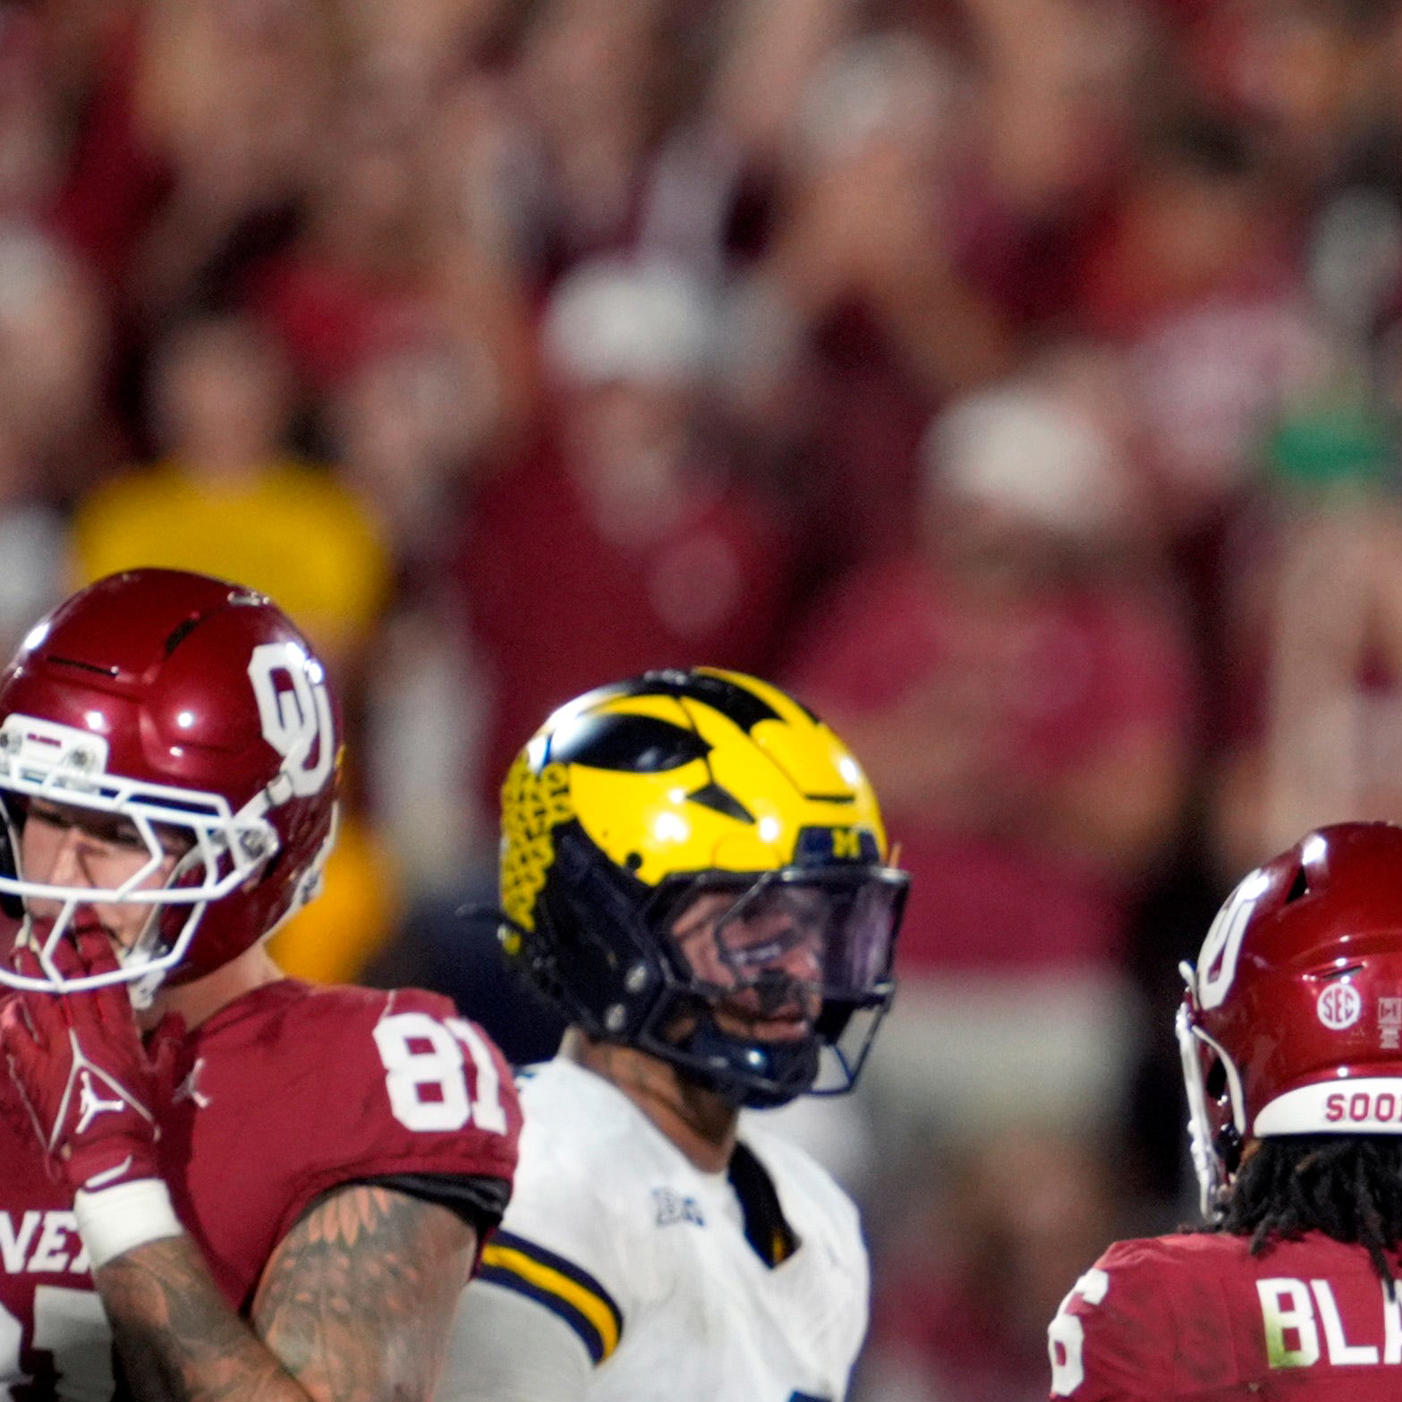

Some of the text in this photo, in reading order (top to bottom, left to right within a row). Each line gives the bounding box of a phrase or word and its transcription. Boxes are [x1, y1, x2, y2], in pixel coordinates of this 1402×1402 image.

[248, 643, 333, 794] OU
[1320, 987, 1356, 1027] SEC
[372, 1010, 507, 1134] 81
